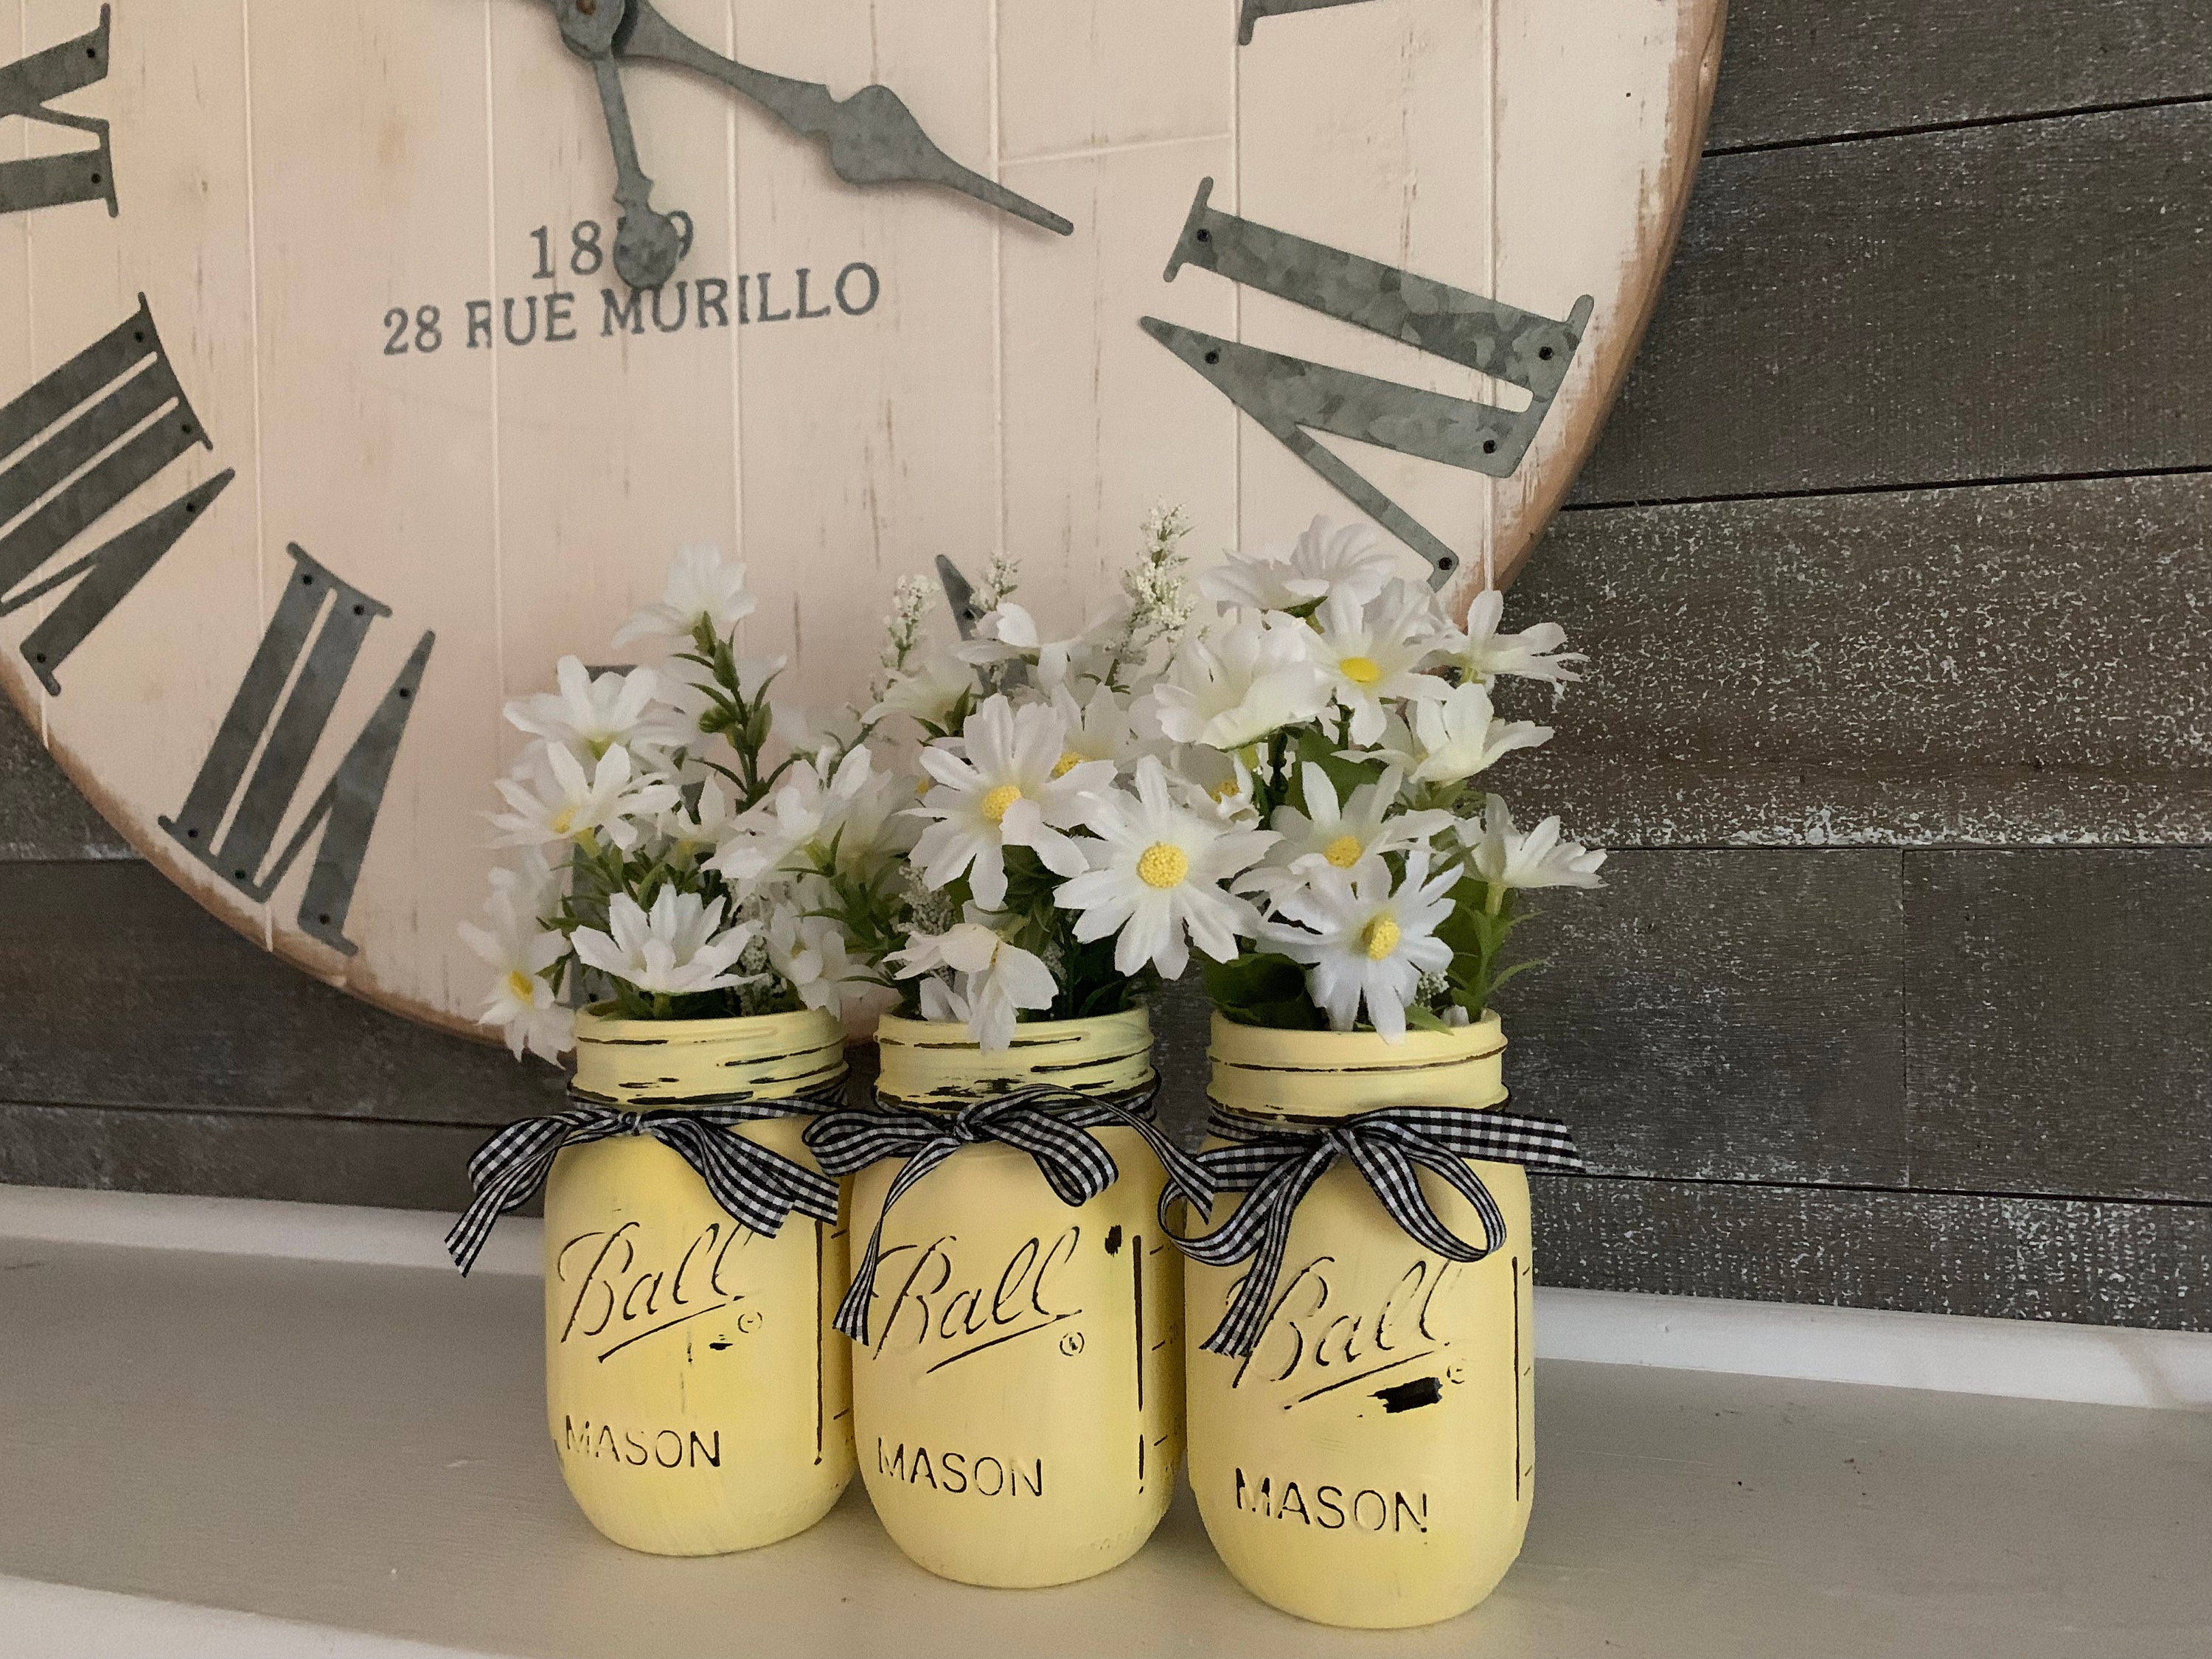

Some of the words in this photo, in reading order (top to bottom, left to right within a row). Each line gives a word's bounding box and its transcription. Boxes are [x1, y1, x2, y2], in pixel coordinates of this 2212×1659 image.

[383, 305, 442, 355] 28
[465, 291, 577, 349] RUE
[600, 262, 880, 337] MURILLO
[557, 1221, 754, 1343] Ball
[872, 1225, 1080, 1360] Ball
[1225, 1256, 1463, 1389] Ball
[566, 1414, 721, 1468] MASON
[877, 1437, 1043, 1498] MASON
[1235, 1467, 1428, 1534] MASON
